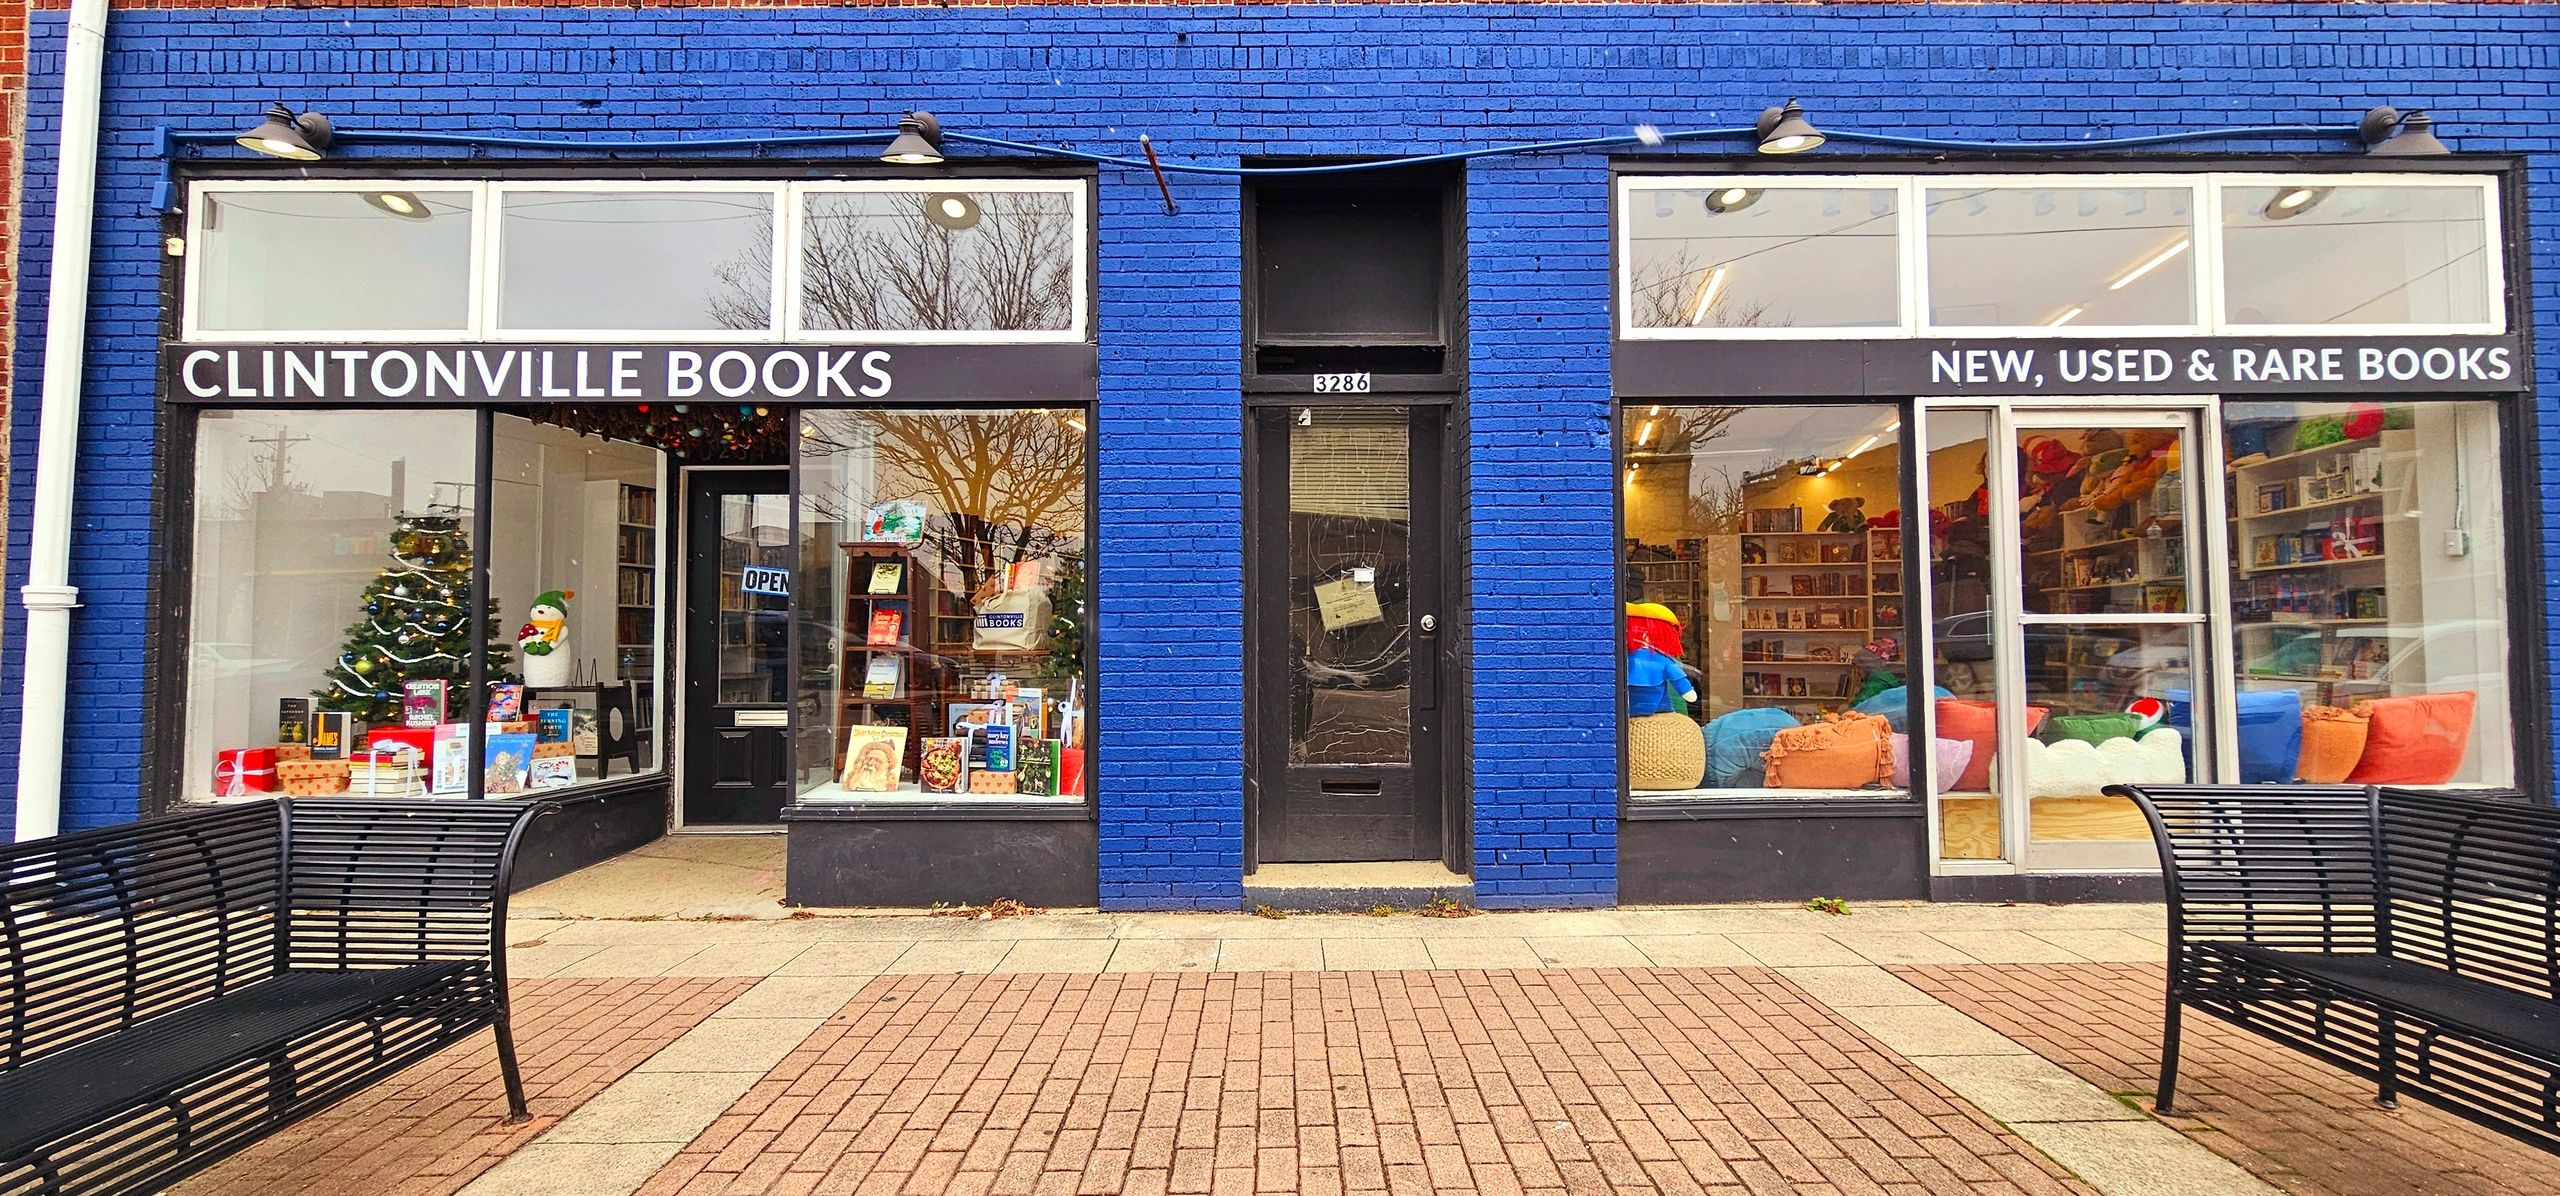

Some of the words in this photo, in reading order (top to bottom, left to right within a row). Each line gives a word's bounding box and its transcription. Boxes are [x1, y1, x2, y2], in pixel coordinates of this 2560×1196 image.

[182, 350, 642, 398] CLINTONVILLE
[668, 350, 892, 398] BOOKS
[1931, 349, 2044, 387] NEW,
[2060, 349, 2172, 382] USED
[2187, 348, 2218, 382] &
[2233, 348, 2344, 381] RARE
[2359, 347, 2511, 381] BOOKS
[1316, 375, 1368, 392] 3286
[745, 570, 789, 592] OPEN
[312, 712, 339, 747] JAMES
[987, 733, 999, 741] mary
